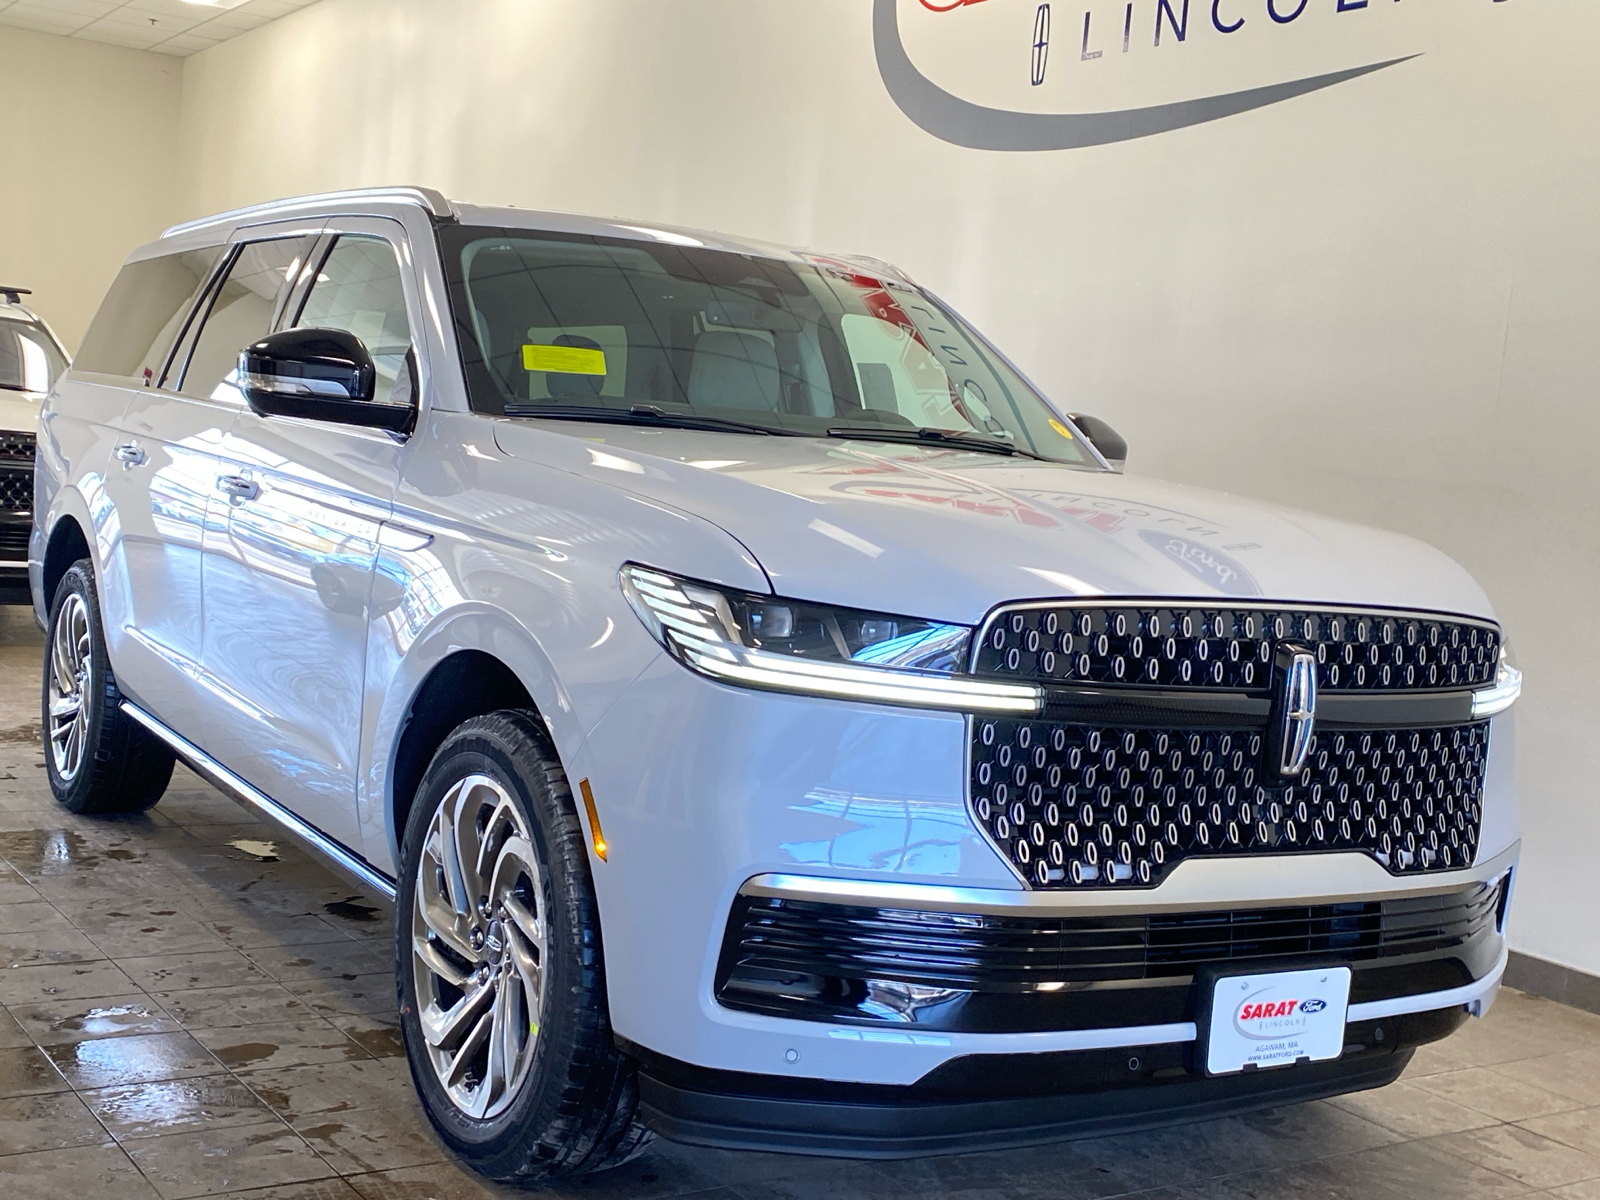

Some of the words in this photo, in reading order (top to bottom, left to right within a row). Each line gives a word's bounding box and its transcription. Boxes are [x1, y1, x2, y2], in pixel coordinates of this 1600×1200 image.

[1240, 1000, 1298, 1020] SARAT
[1301, 1000, 1324, 1012] Ford
[1265, 1019, 1300, 1028] LINCOLN
[1255, 1043, 1286, 1052] AGAWAM,
[1247, 1050, 1304, 1061] WWW.SARATFORD.COM
